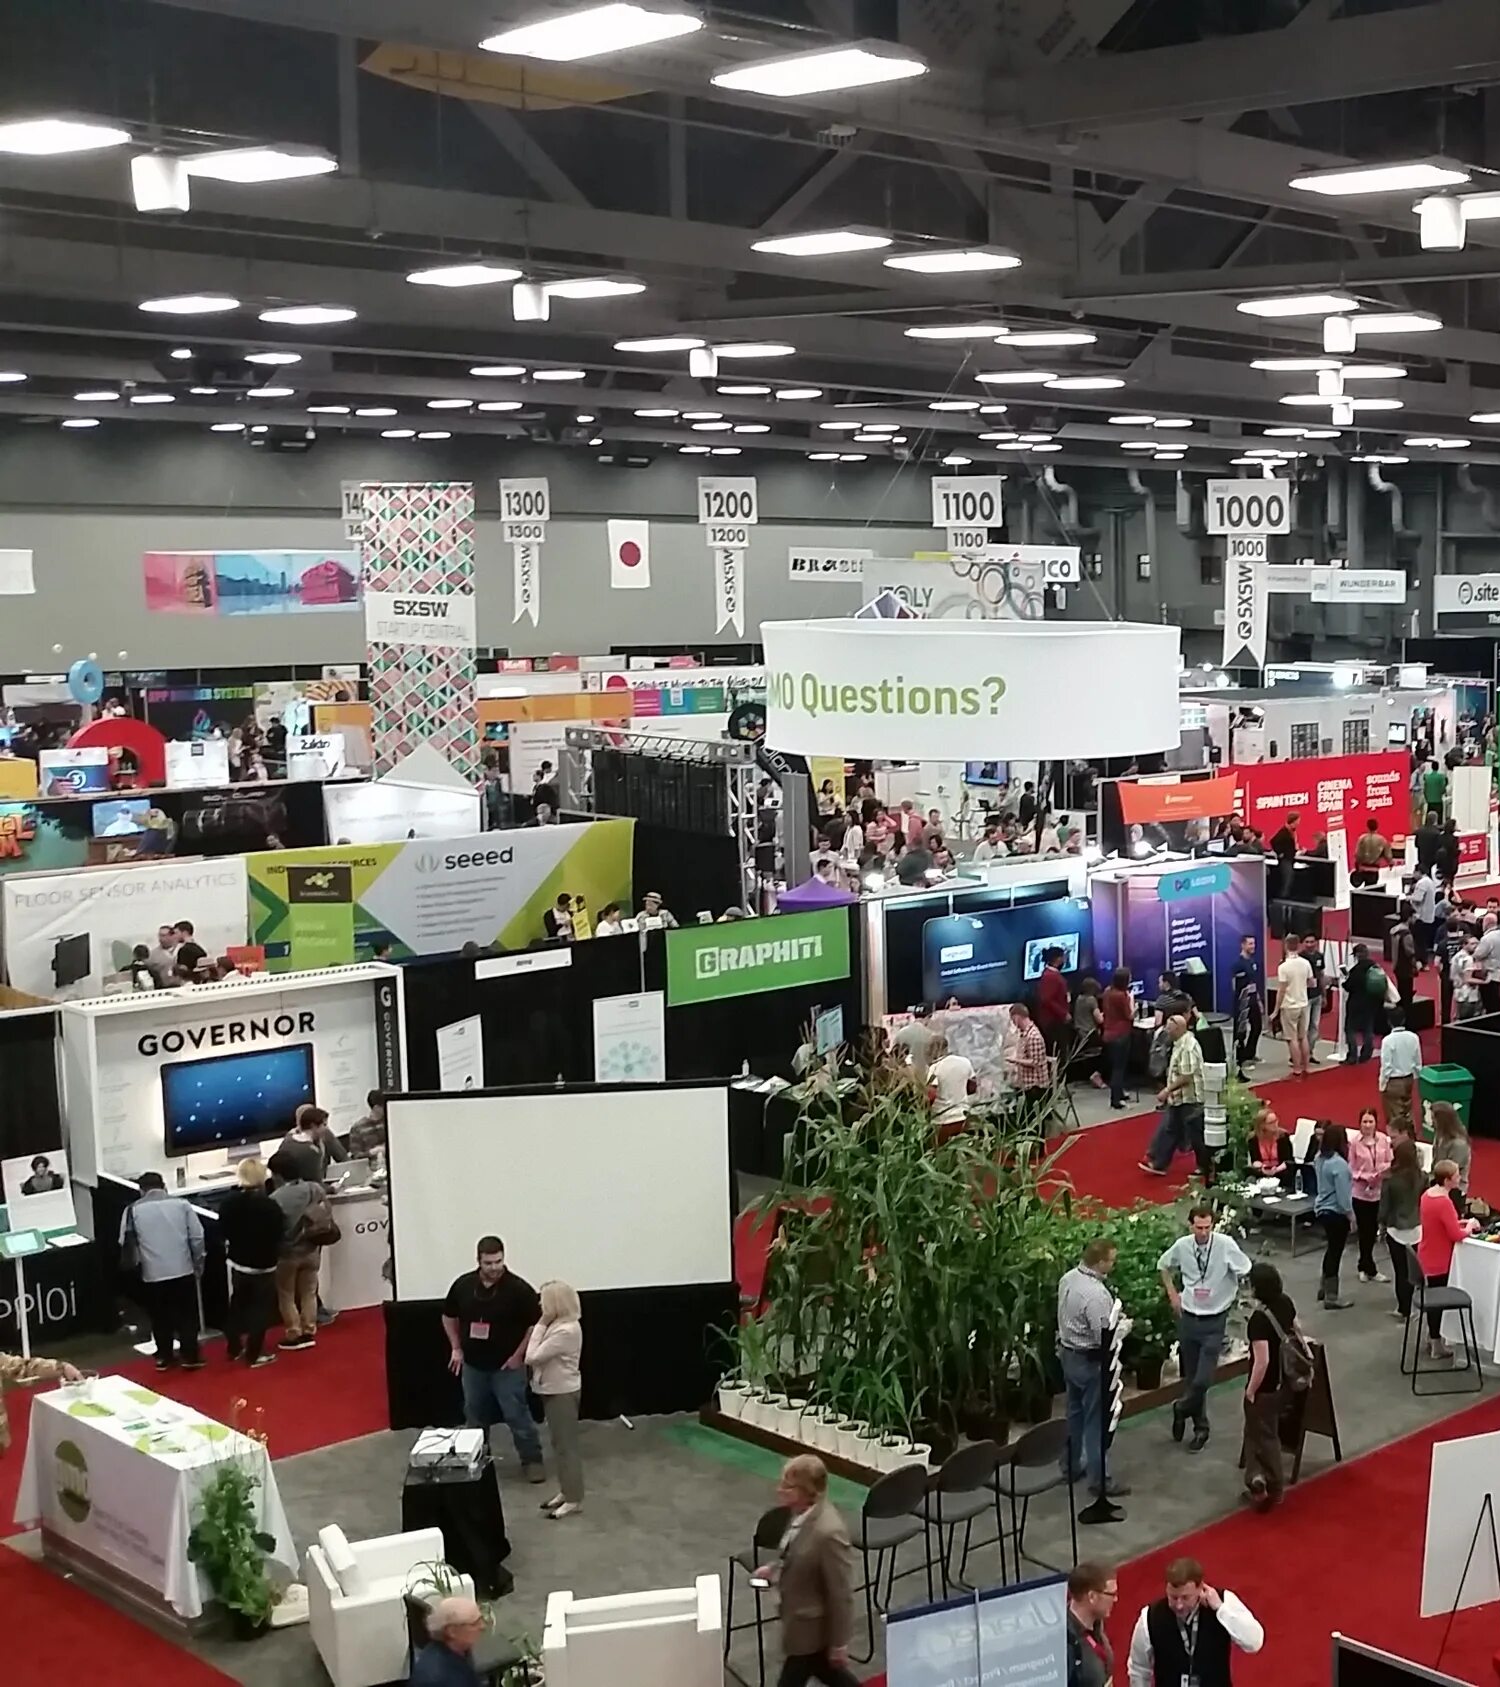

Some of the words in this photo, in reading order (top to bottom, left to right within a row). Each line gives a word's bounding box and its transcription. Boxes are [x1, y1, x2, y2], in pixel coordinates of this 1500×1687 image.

[505, 491, 545, 517] 1300
[703, 491, 753, 519] 1200
[942, 491, 995, 521] 1100
[1215, 494, 1285, 528] 1000
[508, 525, 542, 539] 1300
[711, 527, 746, 543] 1200
[952, 532, 984, 548] 1100
[1231, 540, 1265, 557] 1000
[722, 548, 737, 595] SXSW
[1237, 563, 1253, 619] SXSW
[1473, 582, 1500, 602] .site
[393, 599, 449, 618] SXSW
[801, 672, 1007, 718] Questions?
[1316, 777, 1354, 792] CINEMA
[1316, 788, 1345, 803] FROM
[1366, 784, 1390, 798] from
[1316, 799, 1344, 813] SPAIN
[444, 846, 514, 871] seeed
[14, 891, 72, 909] FLOOR
[151, 873, 237, 892] ANALYTICS
[695, 934, 823, 980] GRAPHITI
[137, 1011, 316, 1057] GOVERNOR
[382, 1011, 396, 1090] GOVERNOR
[354, 1219, 389, 1235] GOV
